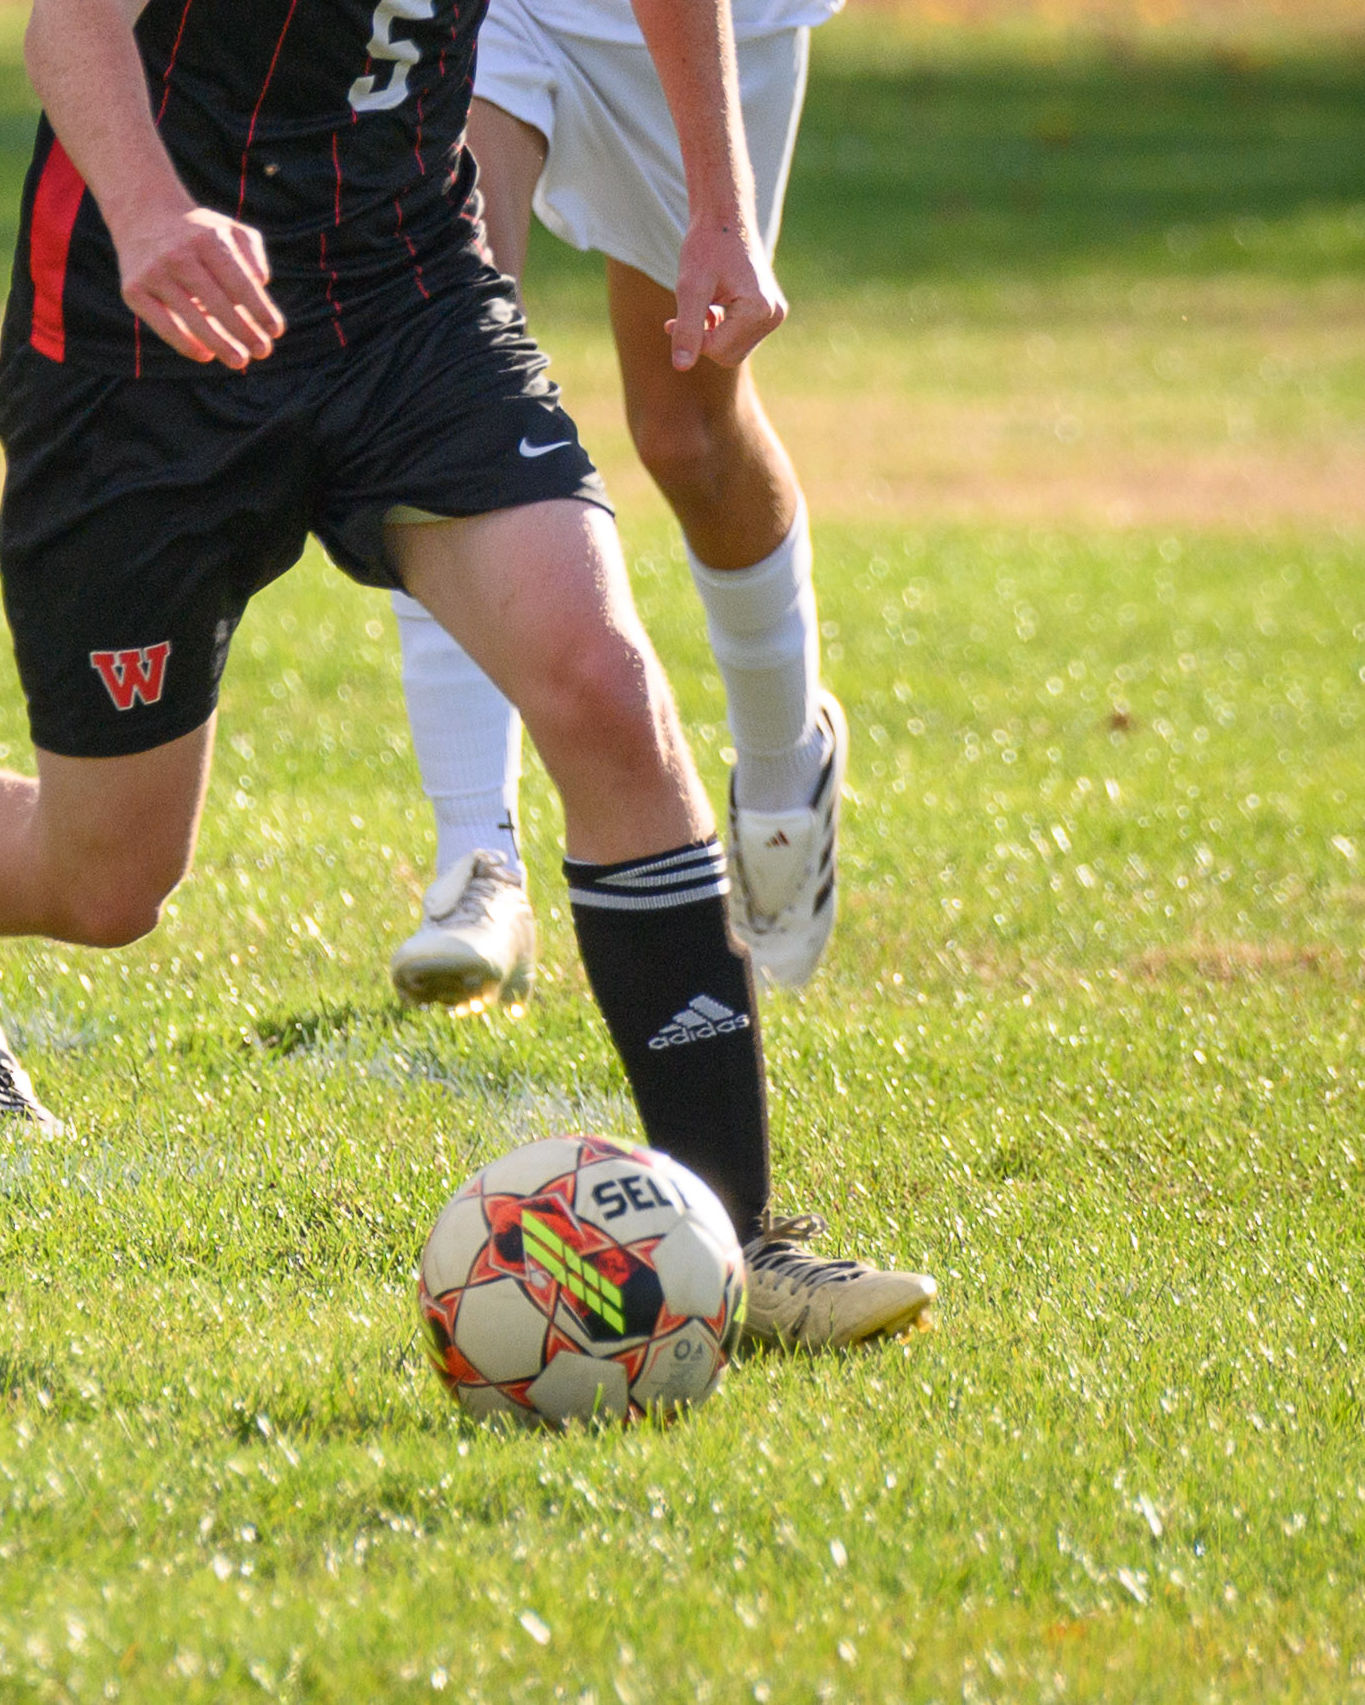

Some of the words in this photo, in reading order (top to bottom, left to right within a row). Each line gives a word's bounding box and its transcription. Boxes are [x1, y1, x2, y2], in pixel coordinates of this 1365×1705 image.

[89, 640, 171, 712] W
[648, 1013, 751, 1050] adidas
[591, 1174, 691, 1222] SEL
